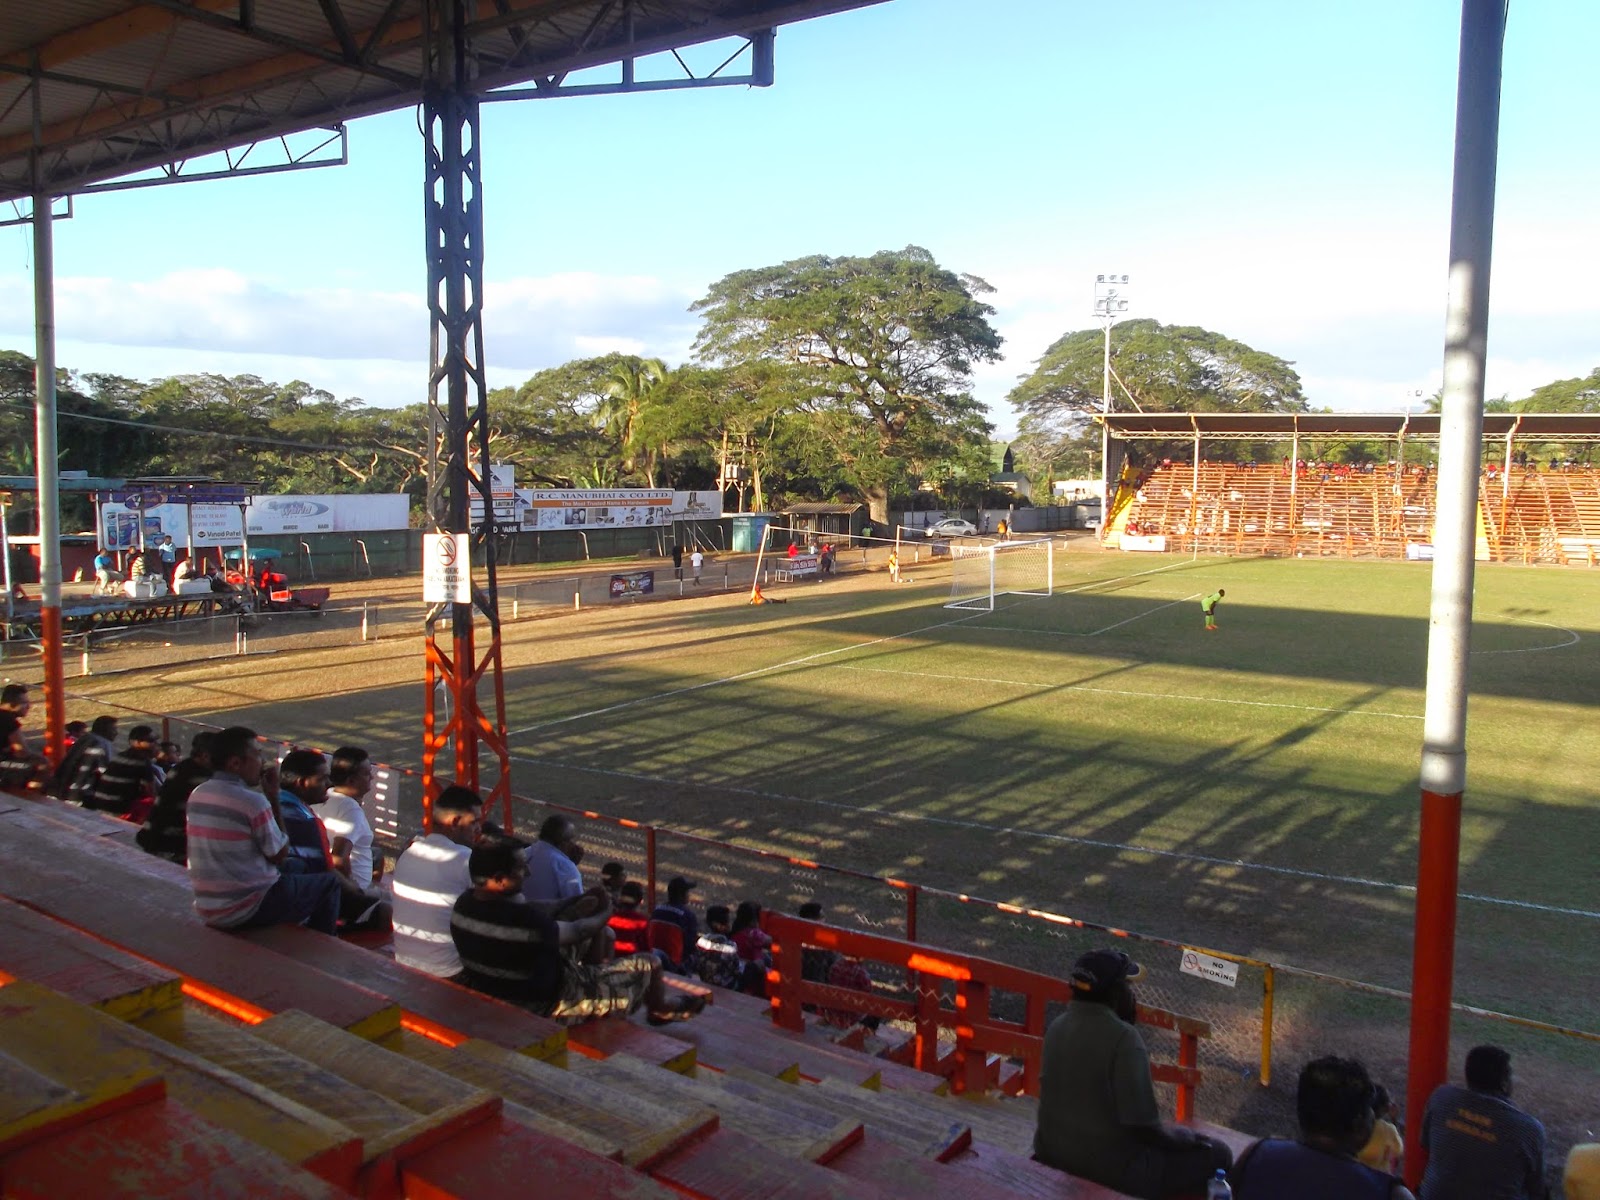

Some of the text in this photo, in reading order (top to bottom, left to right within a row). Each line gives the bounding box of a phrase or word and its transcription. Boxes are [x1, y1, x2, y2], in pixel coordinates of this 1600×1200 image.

[561, 492, 616, 500] MANUBHAI
[1212, 961, 1224, 969] NO
[1197, 966, 1235, 982] SMOKING
